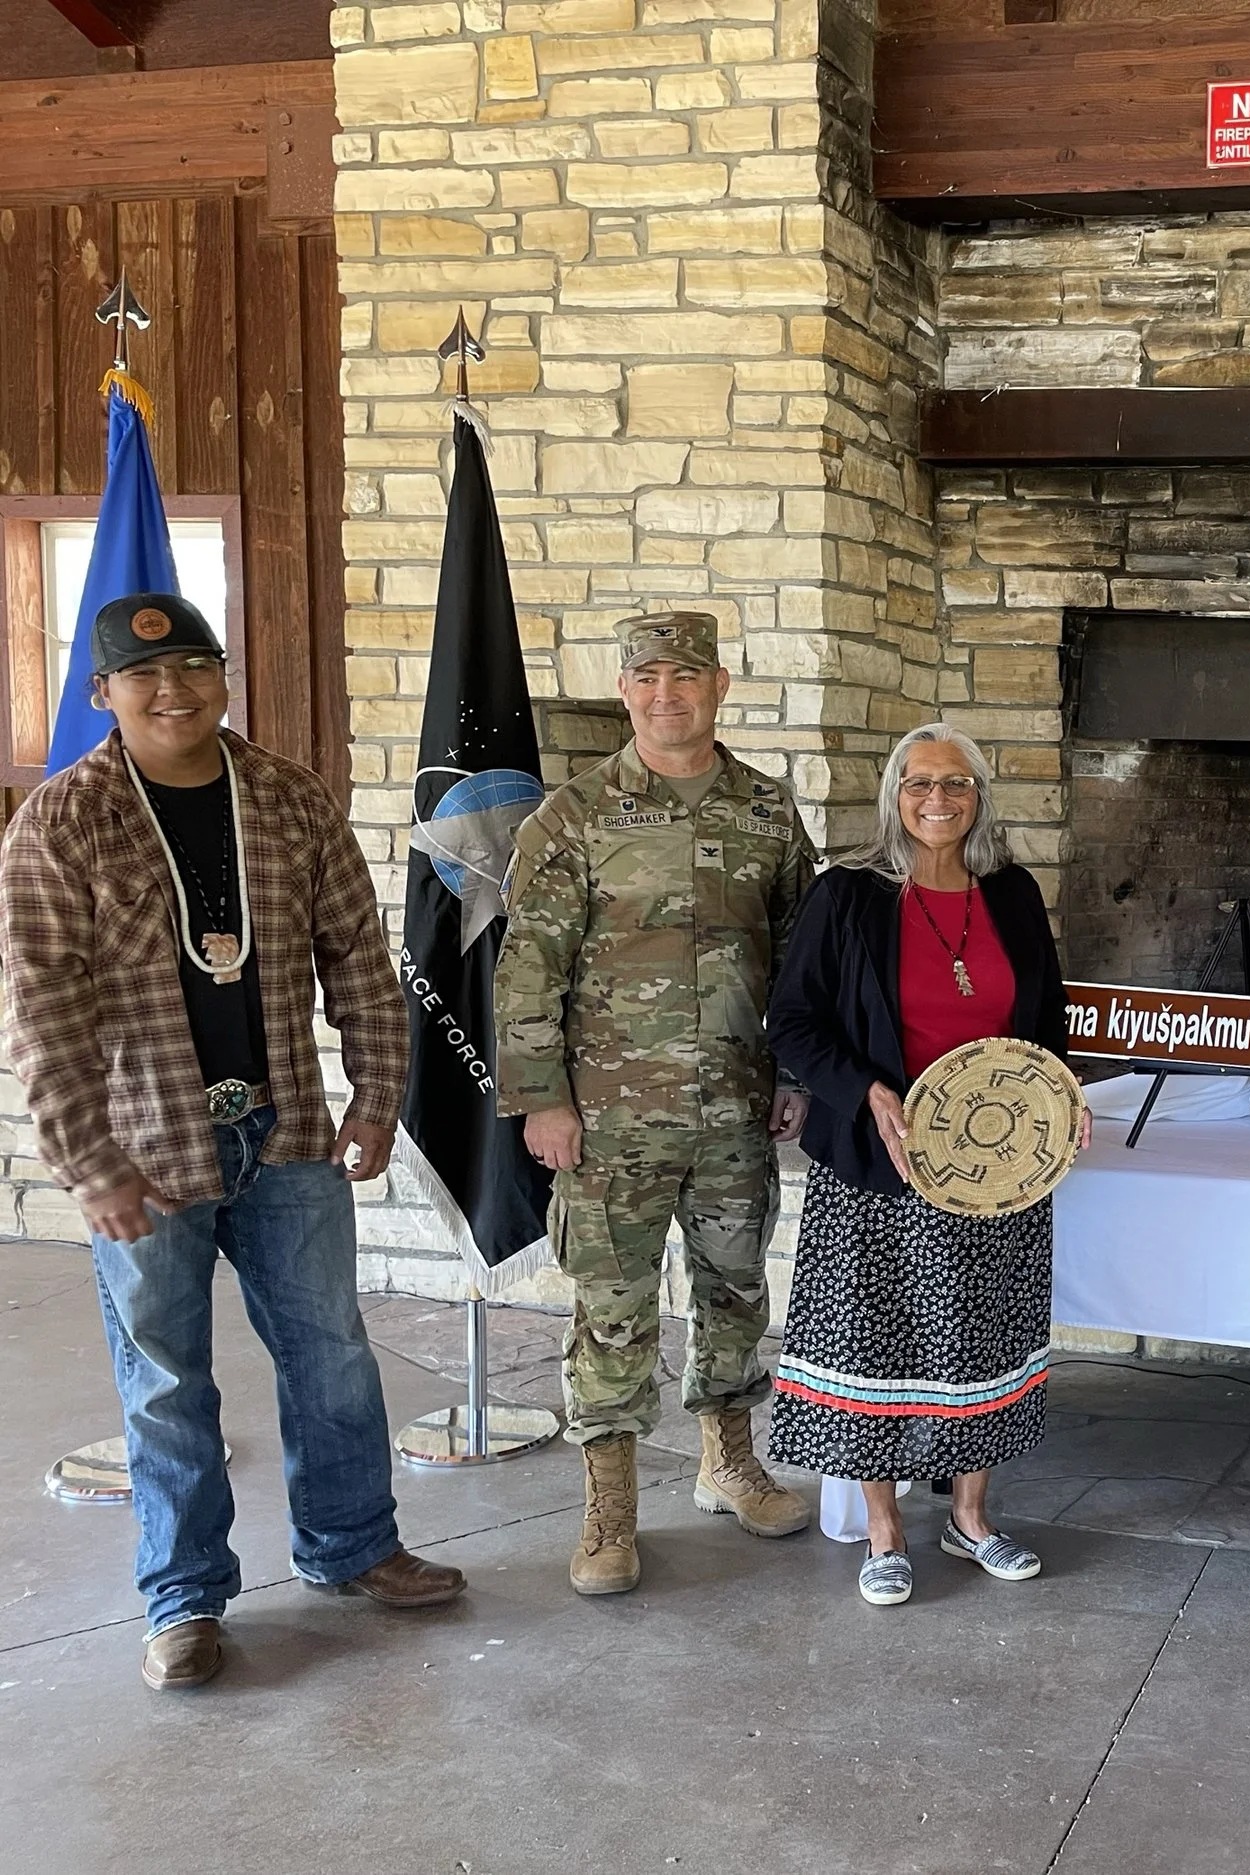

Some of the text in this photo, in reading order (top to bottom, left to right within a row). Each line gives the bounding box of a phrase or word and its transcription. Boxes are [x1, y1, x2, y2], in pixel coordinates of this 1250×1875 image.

[604, 813, 667, 828] SHOEMAKER
[750, 822, 771, 835] SPACE
[772, 825, 790, 840] FORCE
[400, 947, 495, 1094] PACE FORCE
[1065, 1004, 1098, 1037] ma
